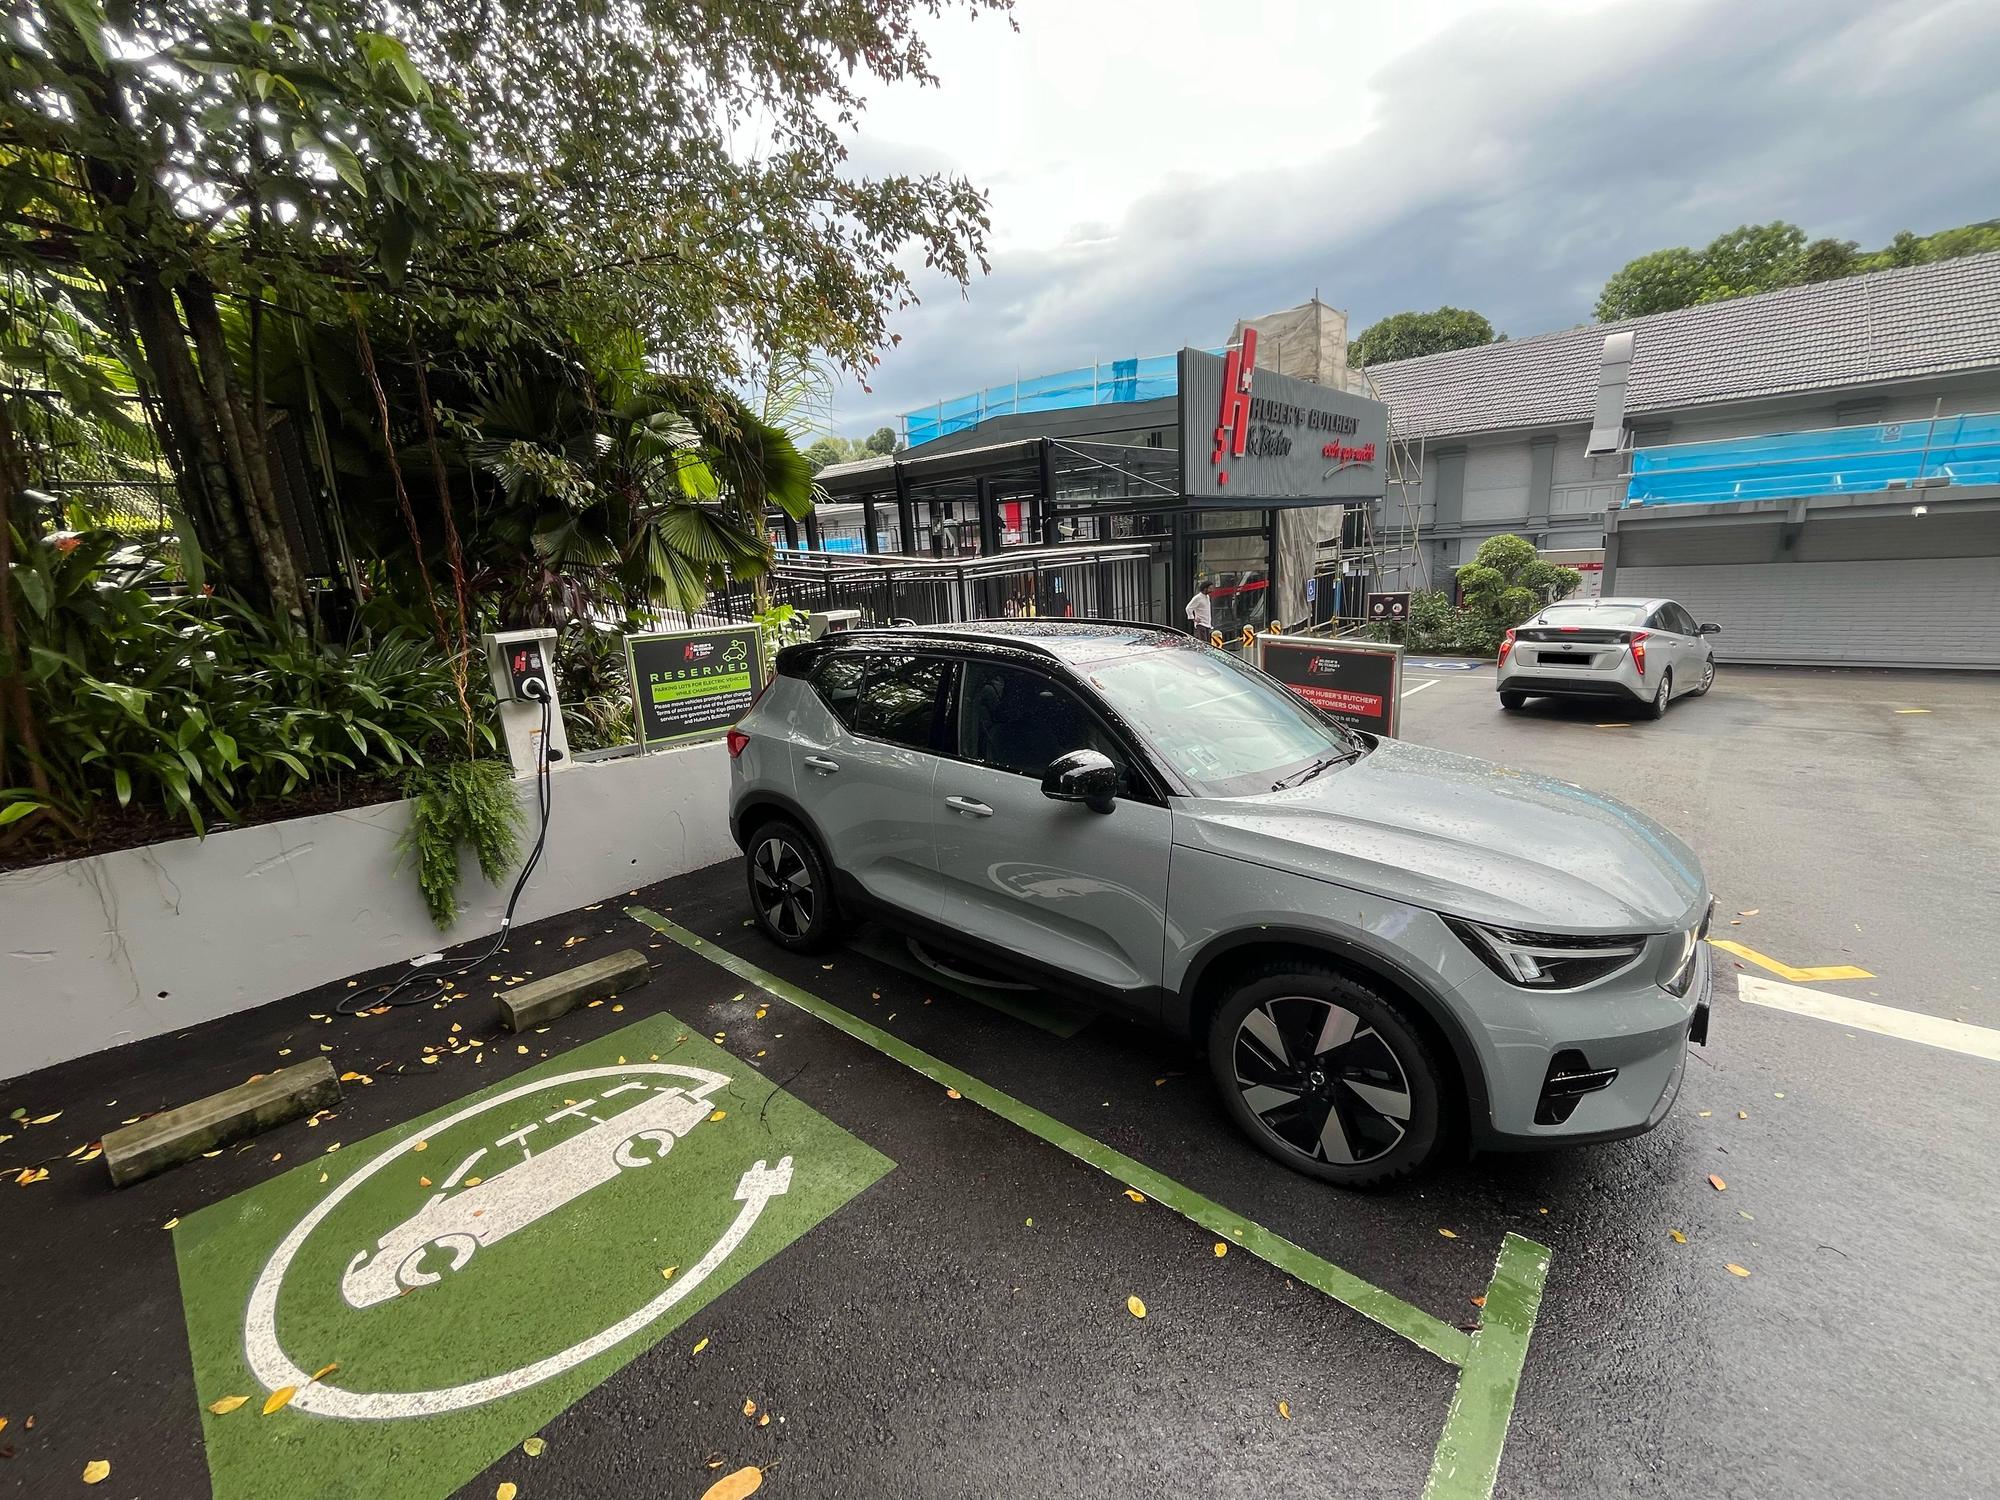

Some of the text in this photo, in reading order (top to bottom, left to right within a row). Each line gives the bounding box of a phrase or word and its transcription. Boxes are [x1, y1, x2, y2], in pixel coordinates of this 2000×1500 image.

[1251, 398, 1360, 435] HUBER'S BUTCHERY
[650, 662, 748, 682] RESERVED
[1303, 688, 1315, 696] FOR
[1315, 690, 1341, 700] HUBER'S
[1343, 694, 1378, 705] BUTCHERY
[1310, 698, 1347, 710] CUSTOMERS
[1348, 703, 1365, 712] ONLY
